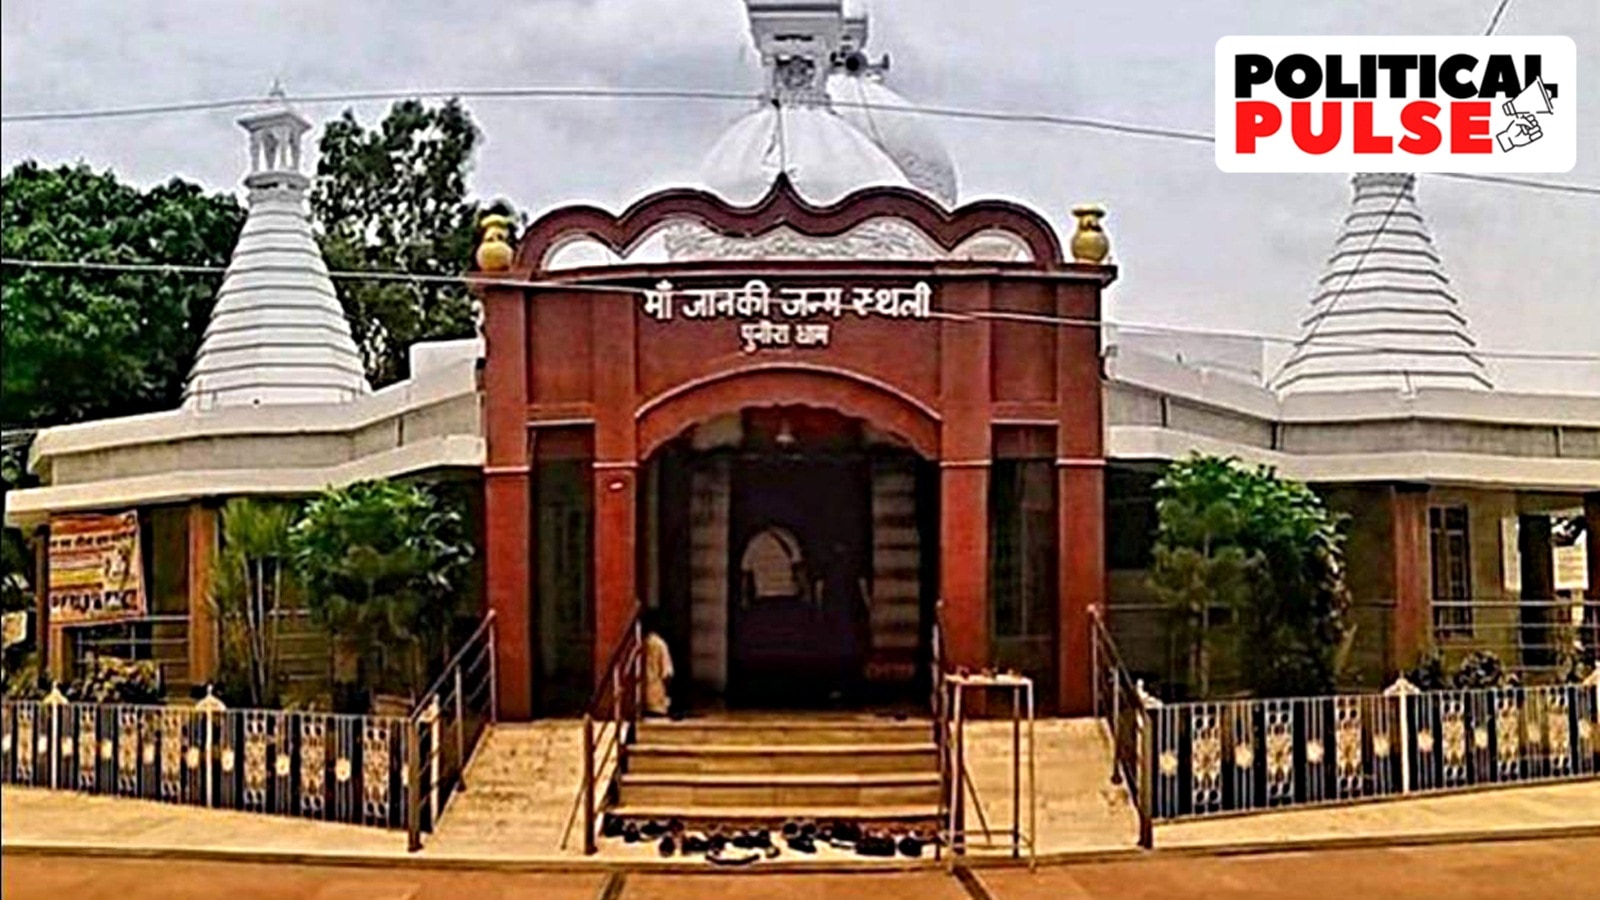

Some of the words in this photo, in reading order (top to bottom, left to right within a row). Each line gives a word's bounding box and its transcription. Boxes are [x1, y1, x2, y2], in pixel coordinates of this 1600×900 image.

[643, 280, 673, 319] माँ
[682, 280, 771, 317] जानकी
[782, 287, 843, 317] जन्म
[852, 281, 932, 317] स्थली
